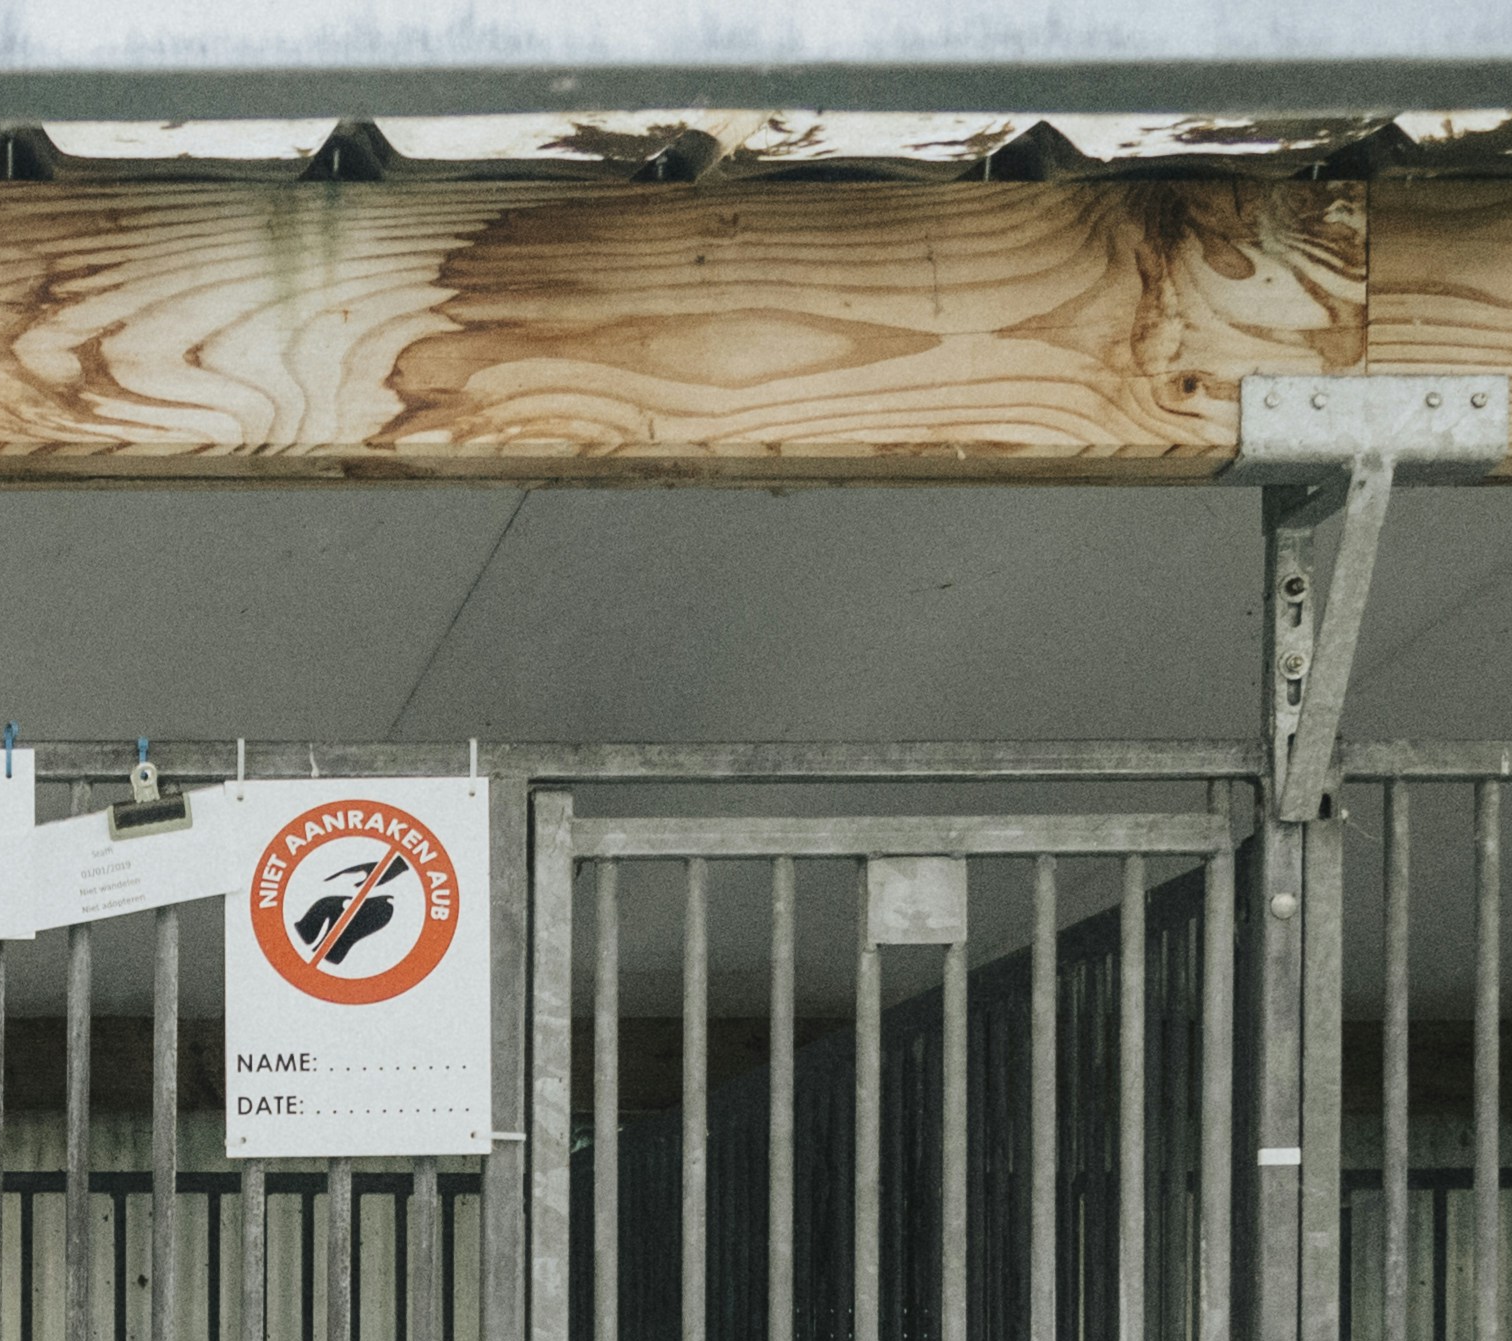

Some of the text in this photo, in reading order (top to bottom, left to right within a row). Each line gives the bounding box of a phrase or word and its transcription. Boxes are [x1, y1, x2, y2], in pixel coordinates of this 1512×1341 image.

[80, 861, 132, 879] 01/01/2019
[259, 810, 451, 921] NIET AANRAKEN AUB
[79, 877, 141, 896] Niet wandelen
[82, 894, 146, 914] Niet adopteren
[237, 1053, 318, 1073] NAME:
[237, 1096, 305, 1115] DATE:
